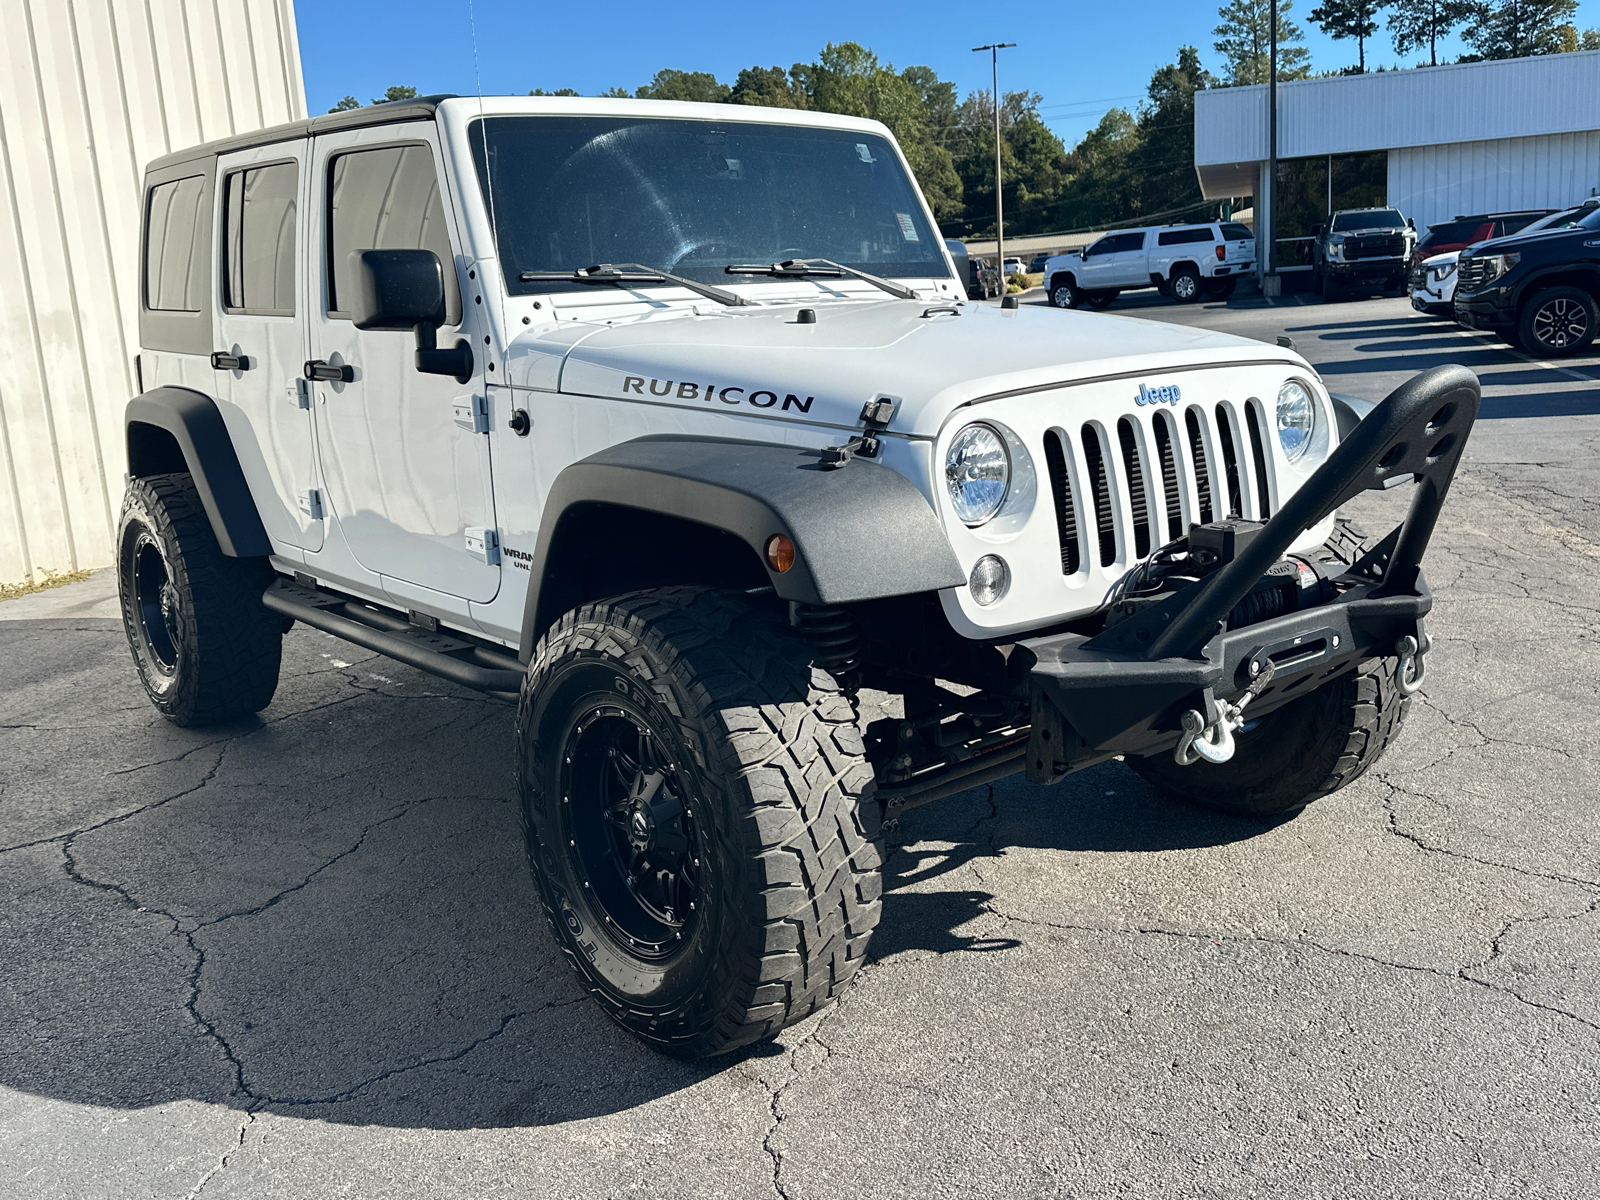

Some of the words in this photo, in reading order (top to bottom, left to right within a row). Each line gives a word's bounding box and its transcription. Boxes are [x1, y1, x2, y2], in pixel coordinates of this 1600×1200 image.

[622, 376, 815, 413] RUBICON
[1133, 383, 1181, 407] Jeep
[541, 845, 598, 963] TOYO
